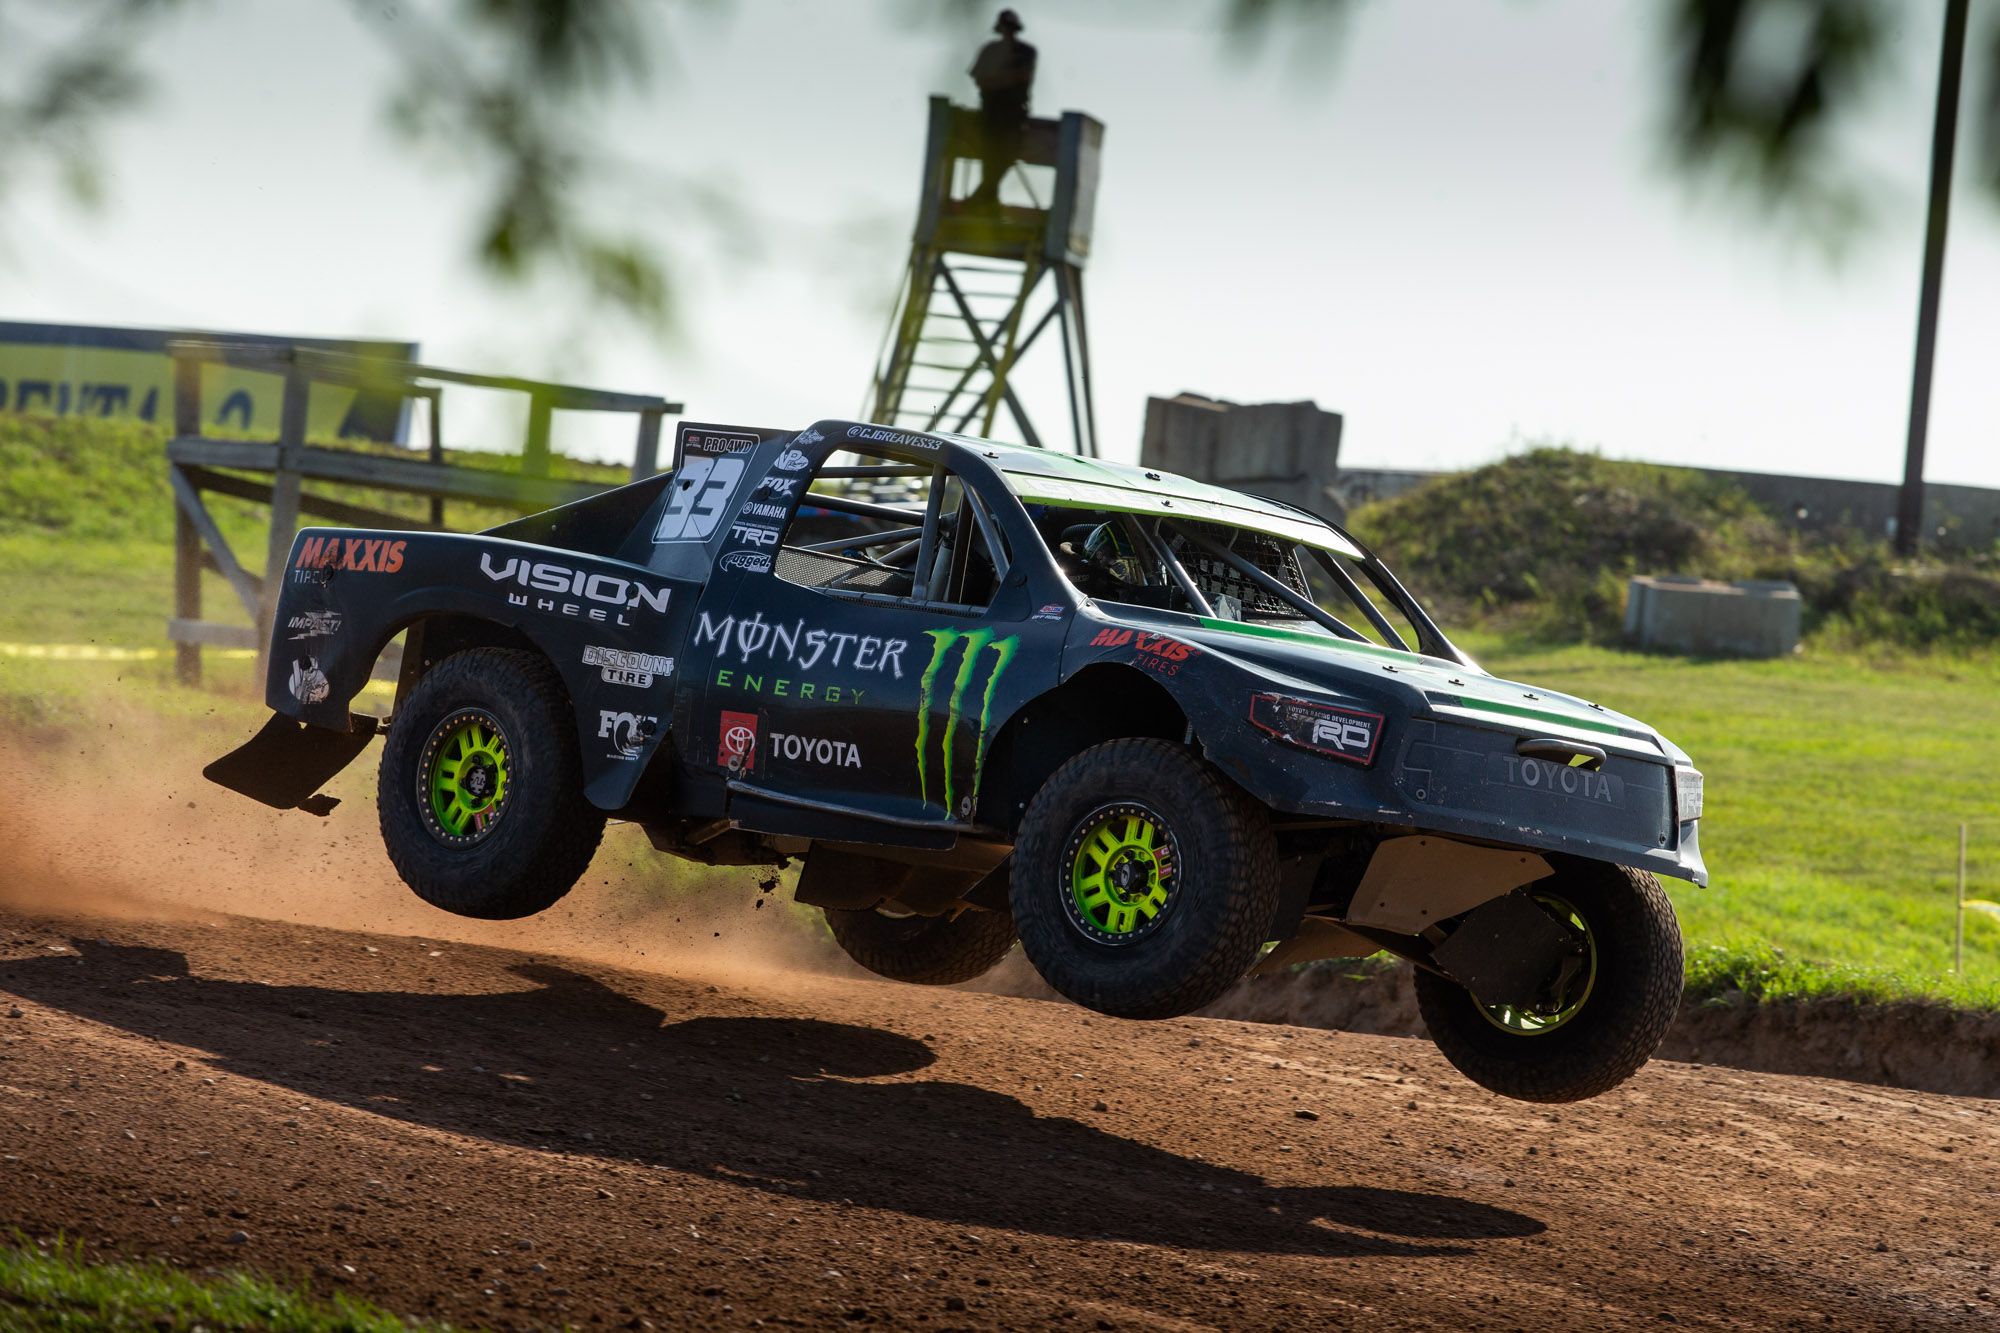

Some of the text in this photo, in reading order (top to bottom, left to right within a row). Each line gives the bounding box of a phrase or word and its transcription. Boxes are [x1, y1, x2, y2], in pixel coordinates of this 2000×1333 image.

[846, 425, 943, 451] @CJGREAVES33
[655, 454, 745, 539] 33
[757, 476, 798, 496] FOX
[752, 503, 787, 519] YAMAHA
[731, 525, 779, 547] TRD
[295, 537, 408, 574] MAXXIS
[294, 569, 331, 584] TIRE
[480, 552, 672, 614] VISION
[508, 592, 631, 627] WHEEL
[582, 645, 675, 677] DISCOUNT
[1089, 628, 1196, 662] MAXXIS
[607, 669, 647, 685] TIRE
[716, 669, 866, 705] ENERGY
[1298, 715, 1370, 751] RD
[769, 732, 863, 769] TOYOTA
[1502, 755, 1612, 802] TOYOTA
